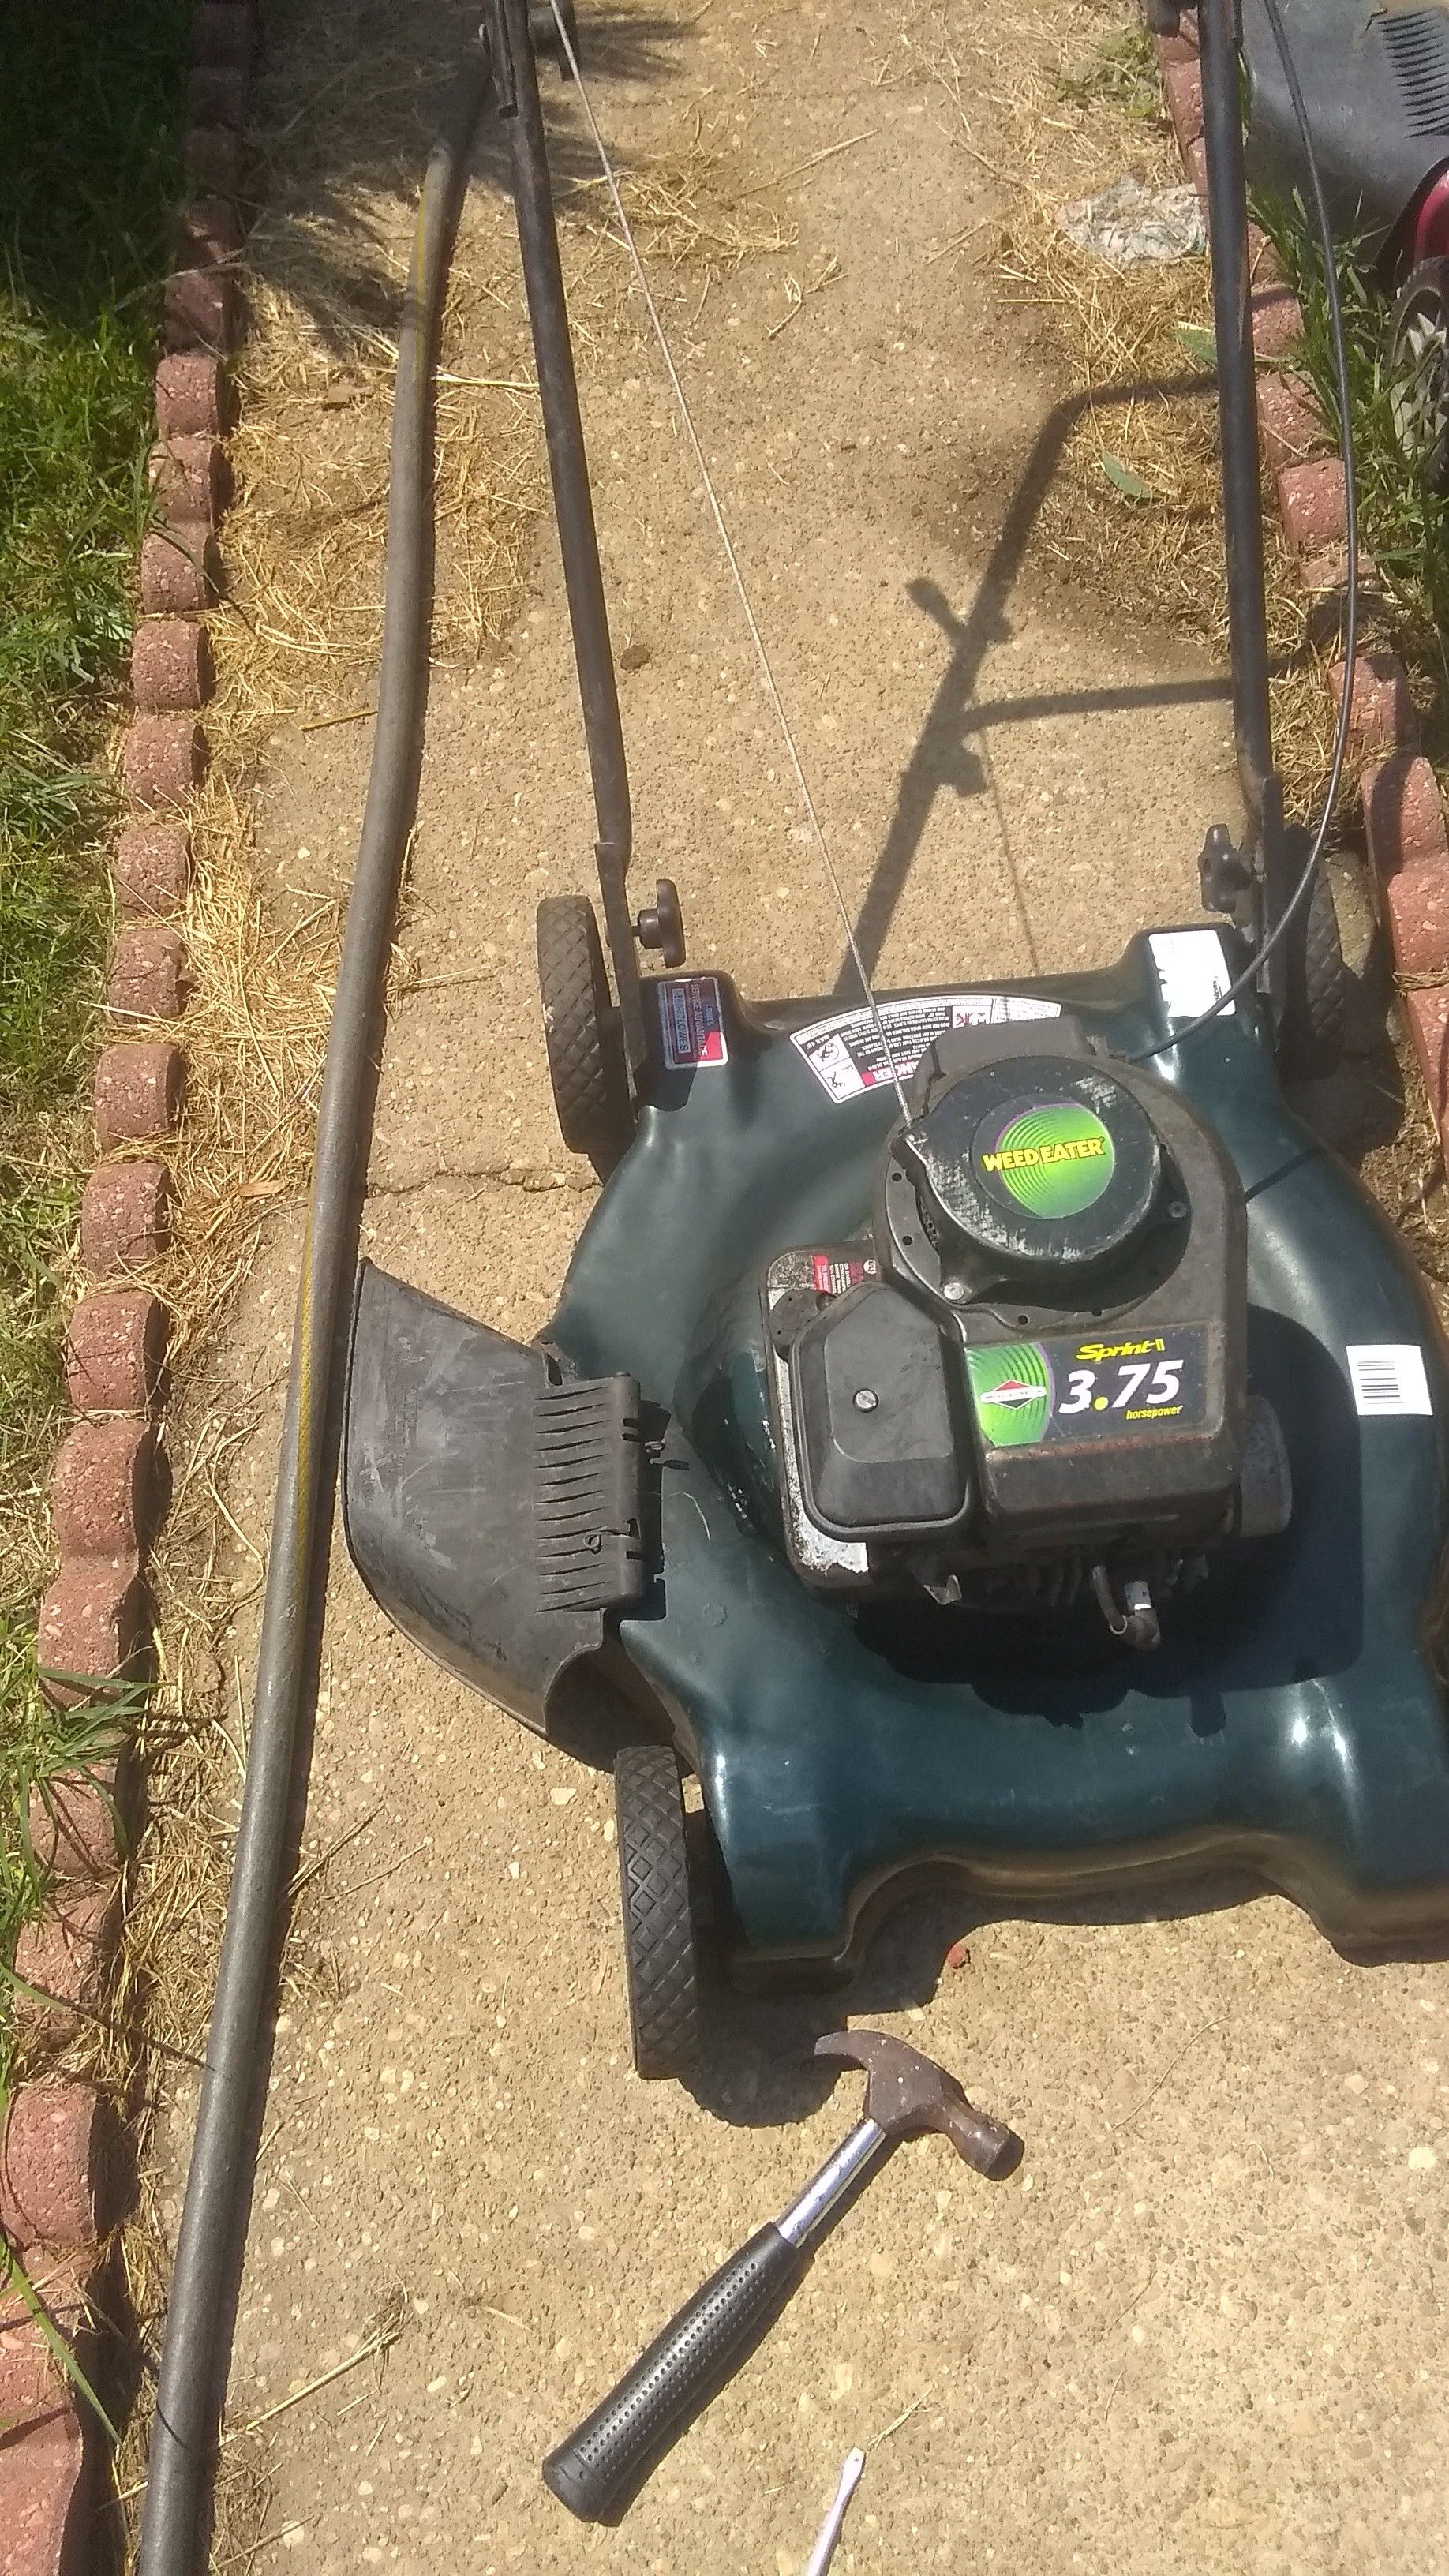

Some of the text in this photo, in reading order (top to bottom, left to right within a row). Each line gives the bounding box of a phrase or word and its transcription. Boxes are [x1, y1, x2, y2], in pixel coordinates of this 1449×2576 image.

[694, 1010, 709, 1057] ADVANTAGE
[982, 1138, 1104, 1172] WEED EATER
[1058, 1359, 1185, 1414] 3.75
[1126, 1405, 1184, 1421] horsepower
